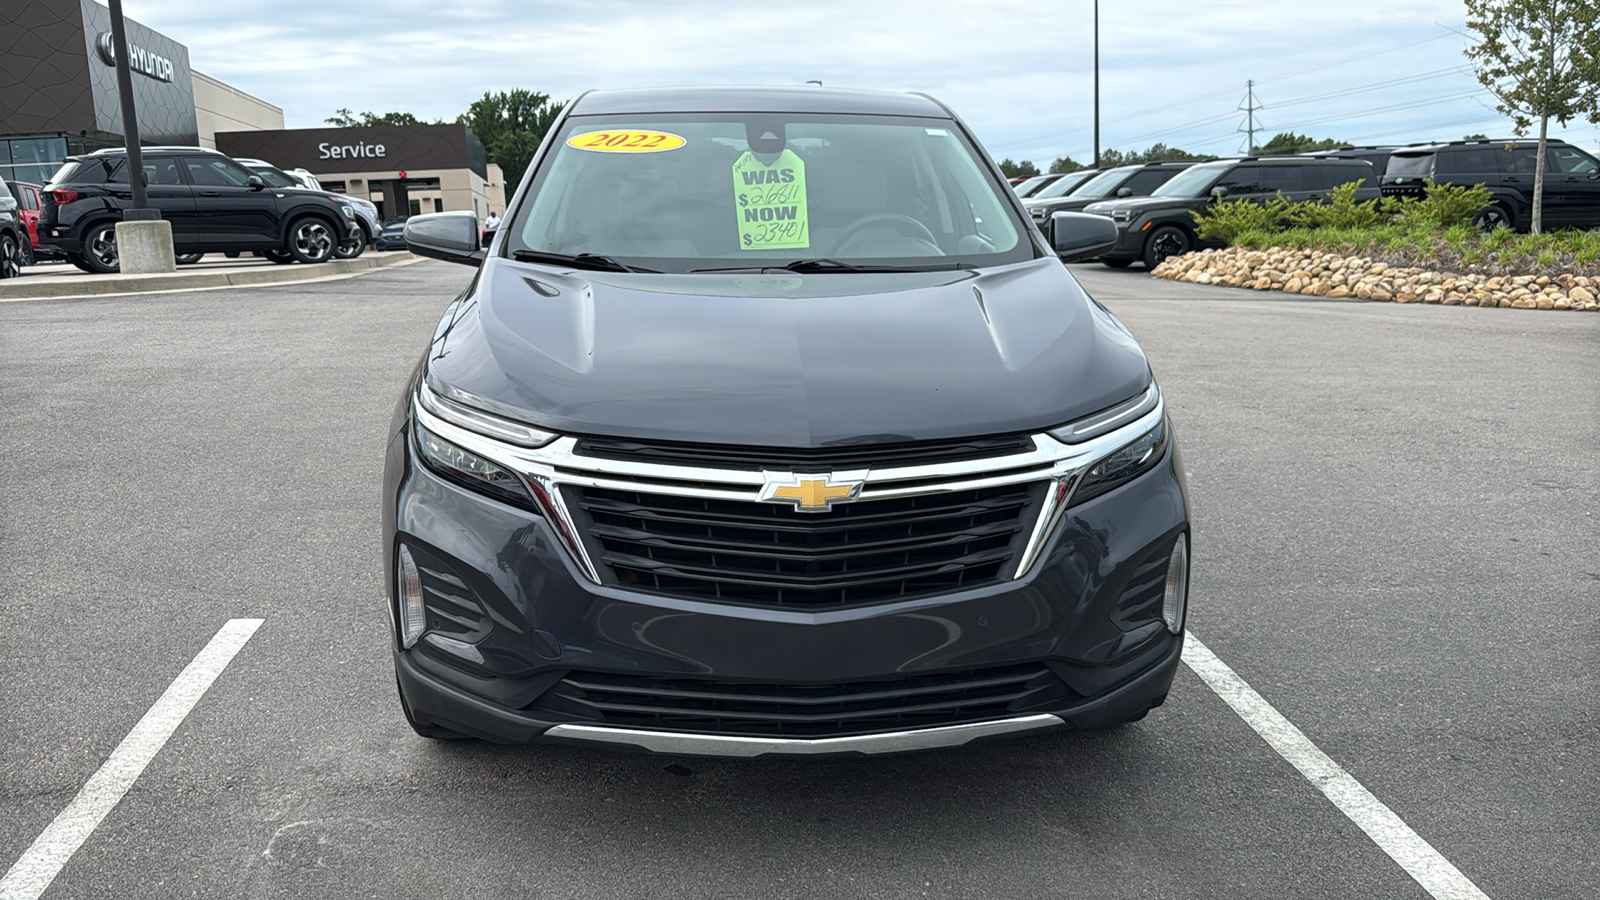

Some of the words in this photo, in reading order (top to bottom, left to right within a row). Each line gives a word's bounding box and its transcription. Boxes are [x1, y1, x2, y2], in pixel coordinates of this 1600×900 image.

[128, 43, 174, 82] HYUNDAI
[583, 134, 667, 148] 2022
[318, 141, 386, 159] Service
[742, 168, 795, 185] WAS
[744, 206, 797, 222] NOW
